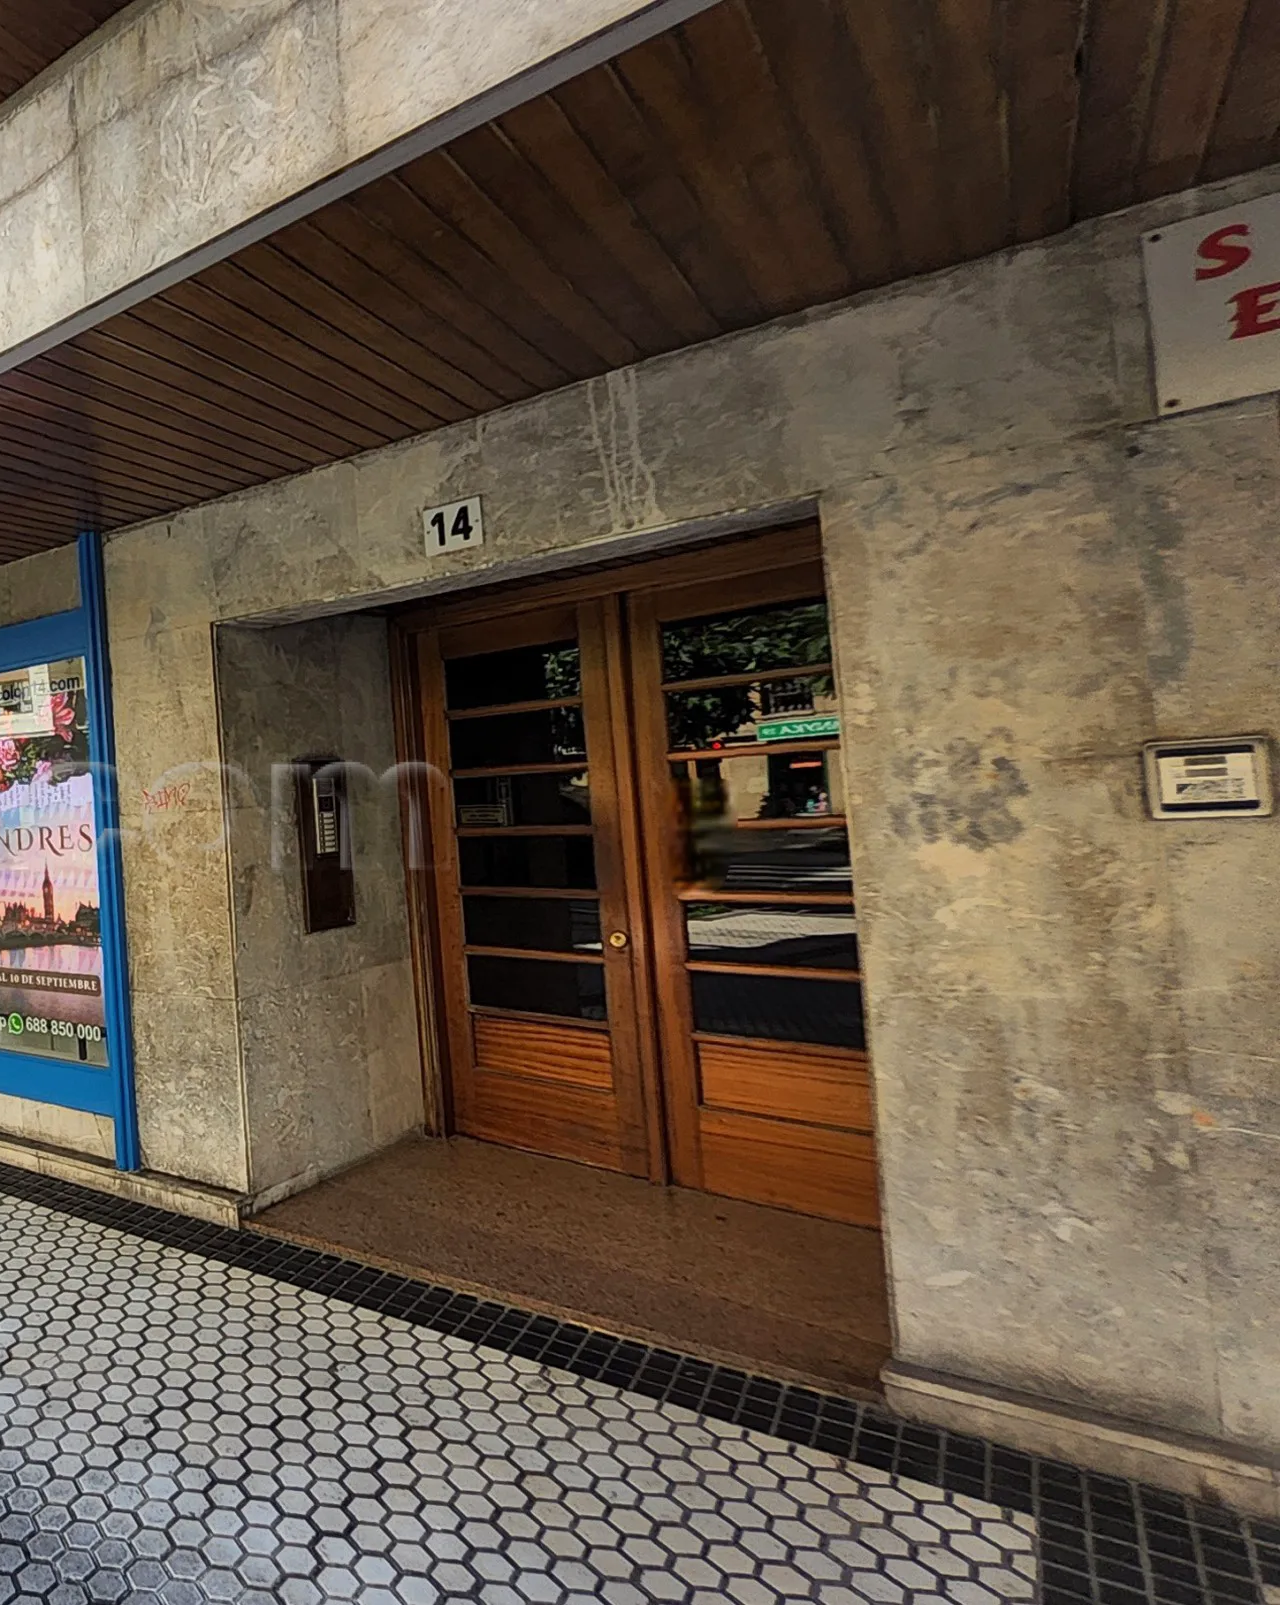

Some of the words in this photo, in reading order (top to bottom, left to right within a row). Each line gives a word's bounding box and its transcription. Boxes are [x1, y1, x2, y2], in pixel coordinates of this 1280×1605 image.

[430, 504, 474, 547] 14
[9, 973, 20, 984] 10
[21, 974, 34, 985] DE
[36, 975, 98, 991] SEPTIEMBRE
[25, 1016, 48, 1034] 688
[51, 1020, 74, 1038] 850
[77, 1024, 102, 1042] 000
